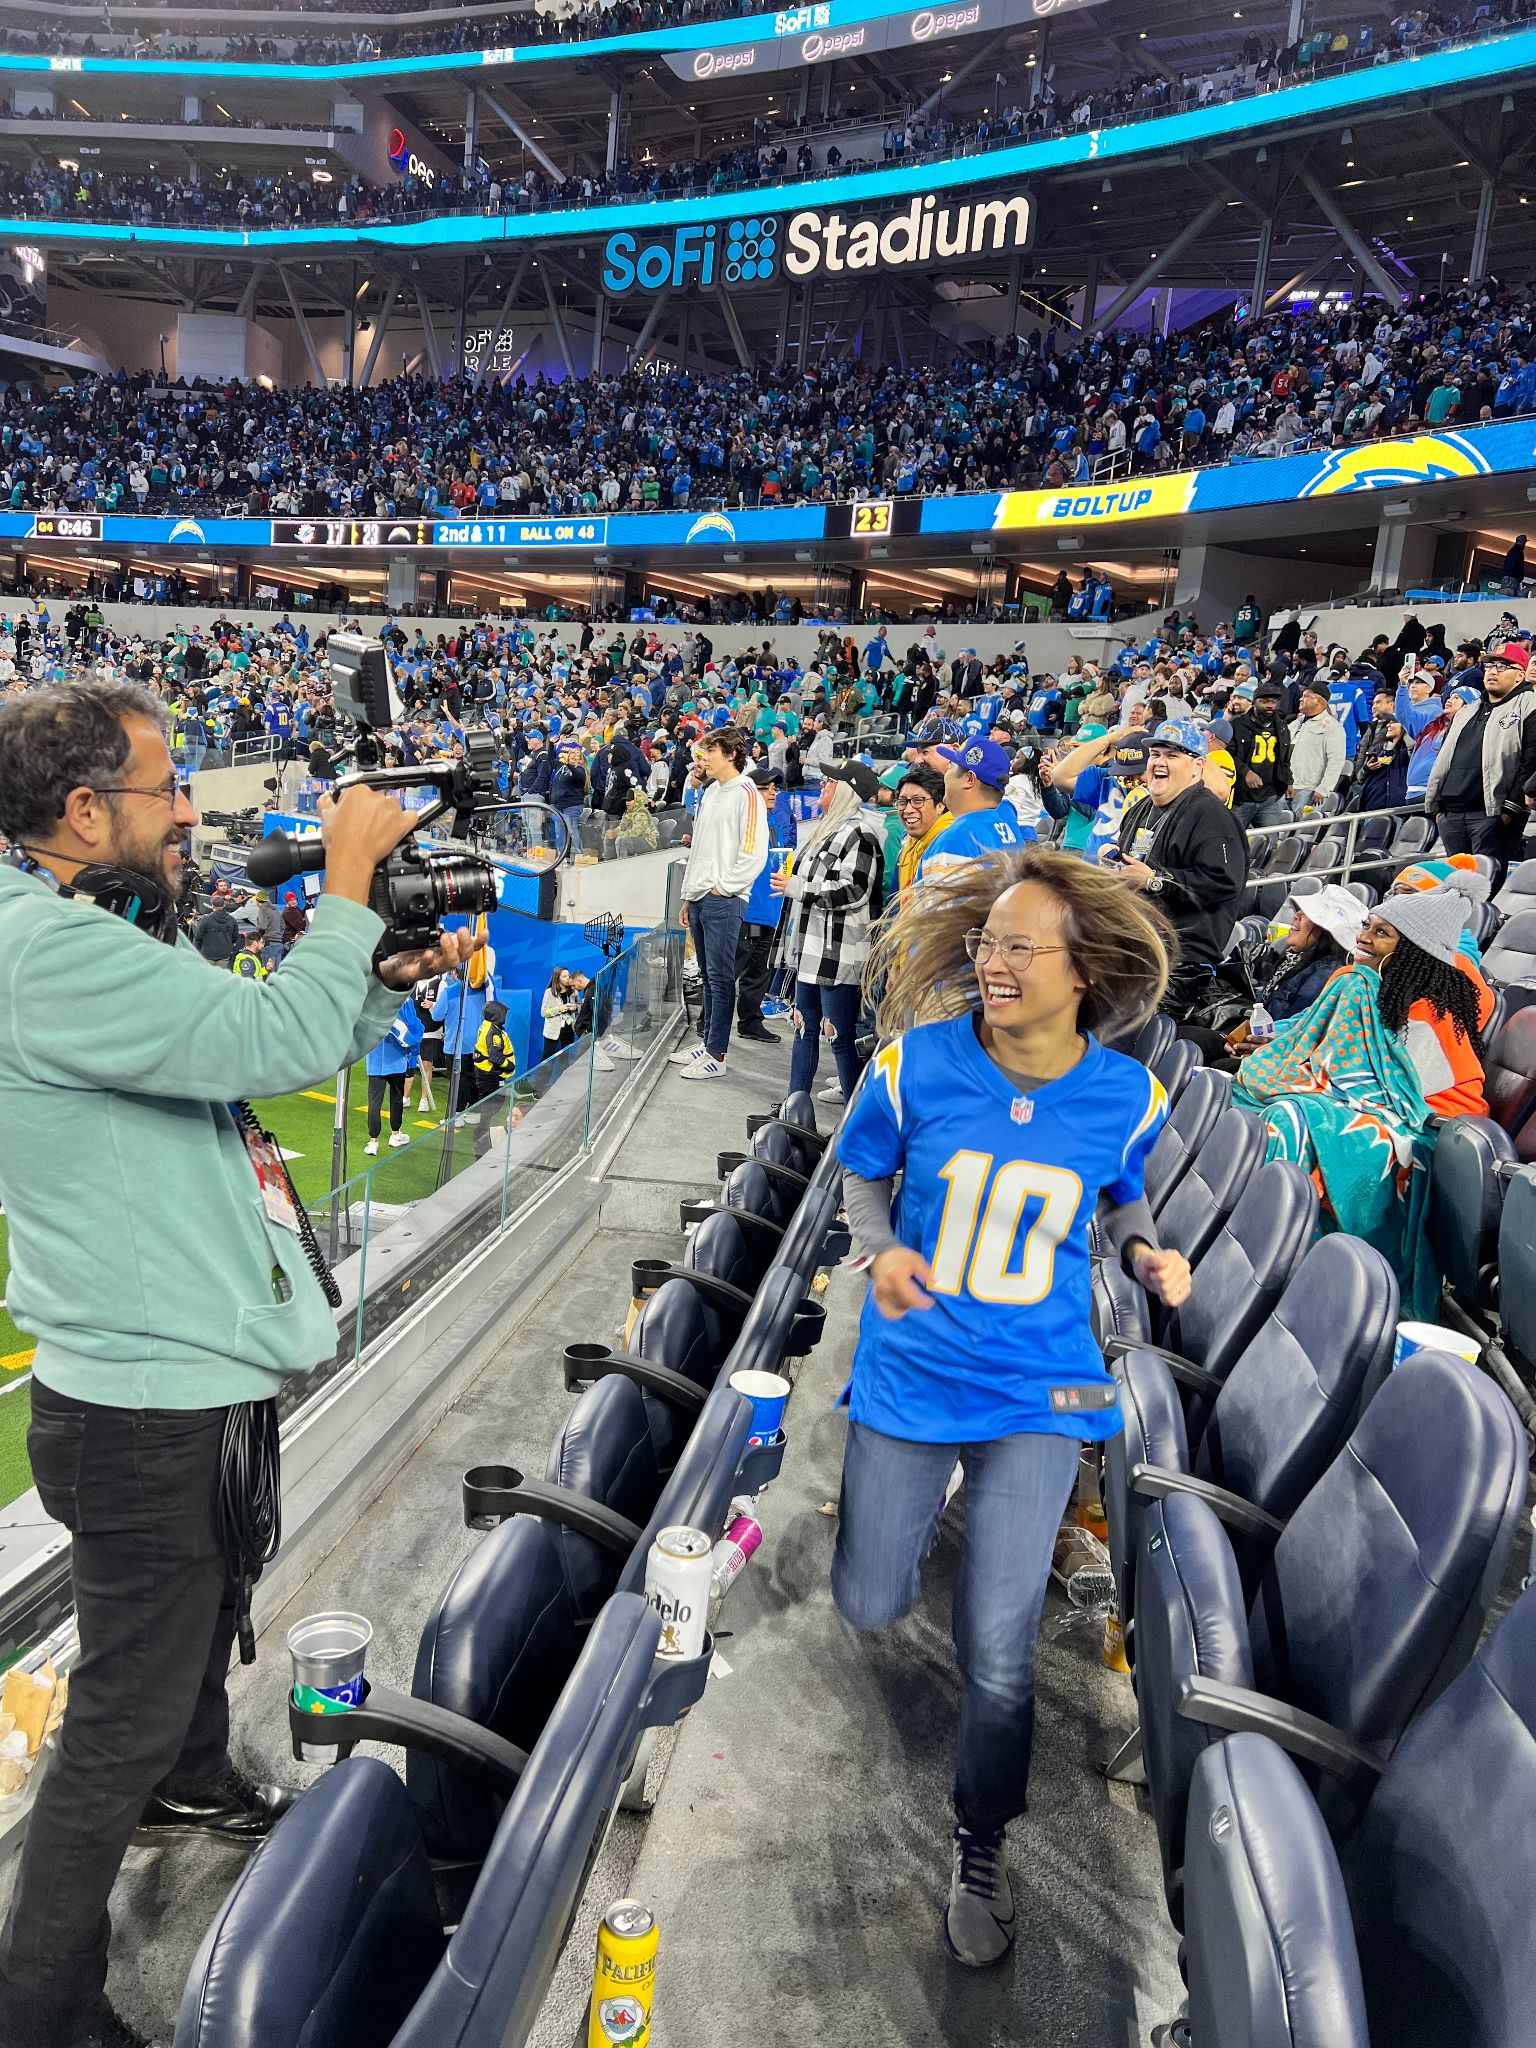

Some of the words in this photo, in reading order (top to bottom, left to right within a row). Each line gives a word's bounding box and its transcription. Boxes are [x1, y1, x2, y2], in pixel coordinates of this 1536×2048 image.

[775, 8, 811, 35] SoFi
[935, 5, 980, 34] pepsi
[822, 28, 865, 56] pepsi
[714, 49, 755, 73] pepsi
[603, 224, 716, 291] SoFi
[786, 195, 1031, 275] Stadium
[1277, 378, 1289, 388] 54
[454, 489, 463, 497] 34
[503, 481, 511, 490] 39
[57, 519, 92, 536] 0:46
[856, 506, 888, 531] 23
[326, 523, 344, 545] 17
[363, 523, 379, 545] 23
[520, 527, 552, 541] BALL
[554, 526, 574, 540] ON
[578, 525, 595, 539] 48
[1238, 609, 1252, 621] 55
[1030, 695, 1047, 712] 10
[278, 712, 288, 726] 10
[926, 1149, 1083, 1305] 10
